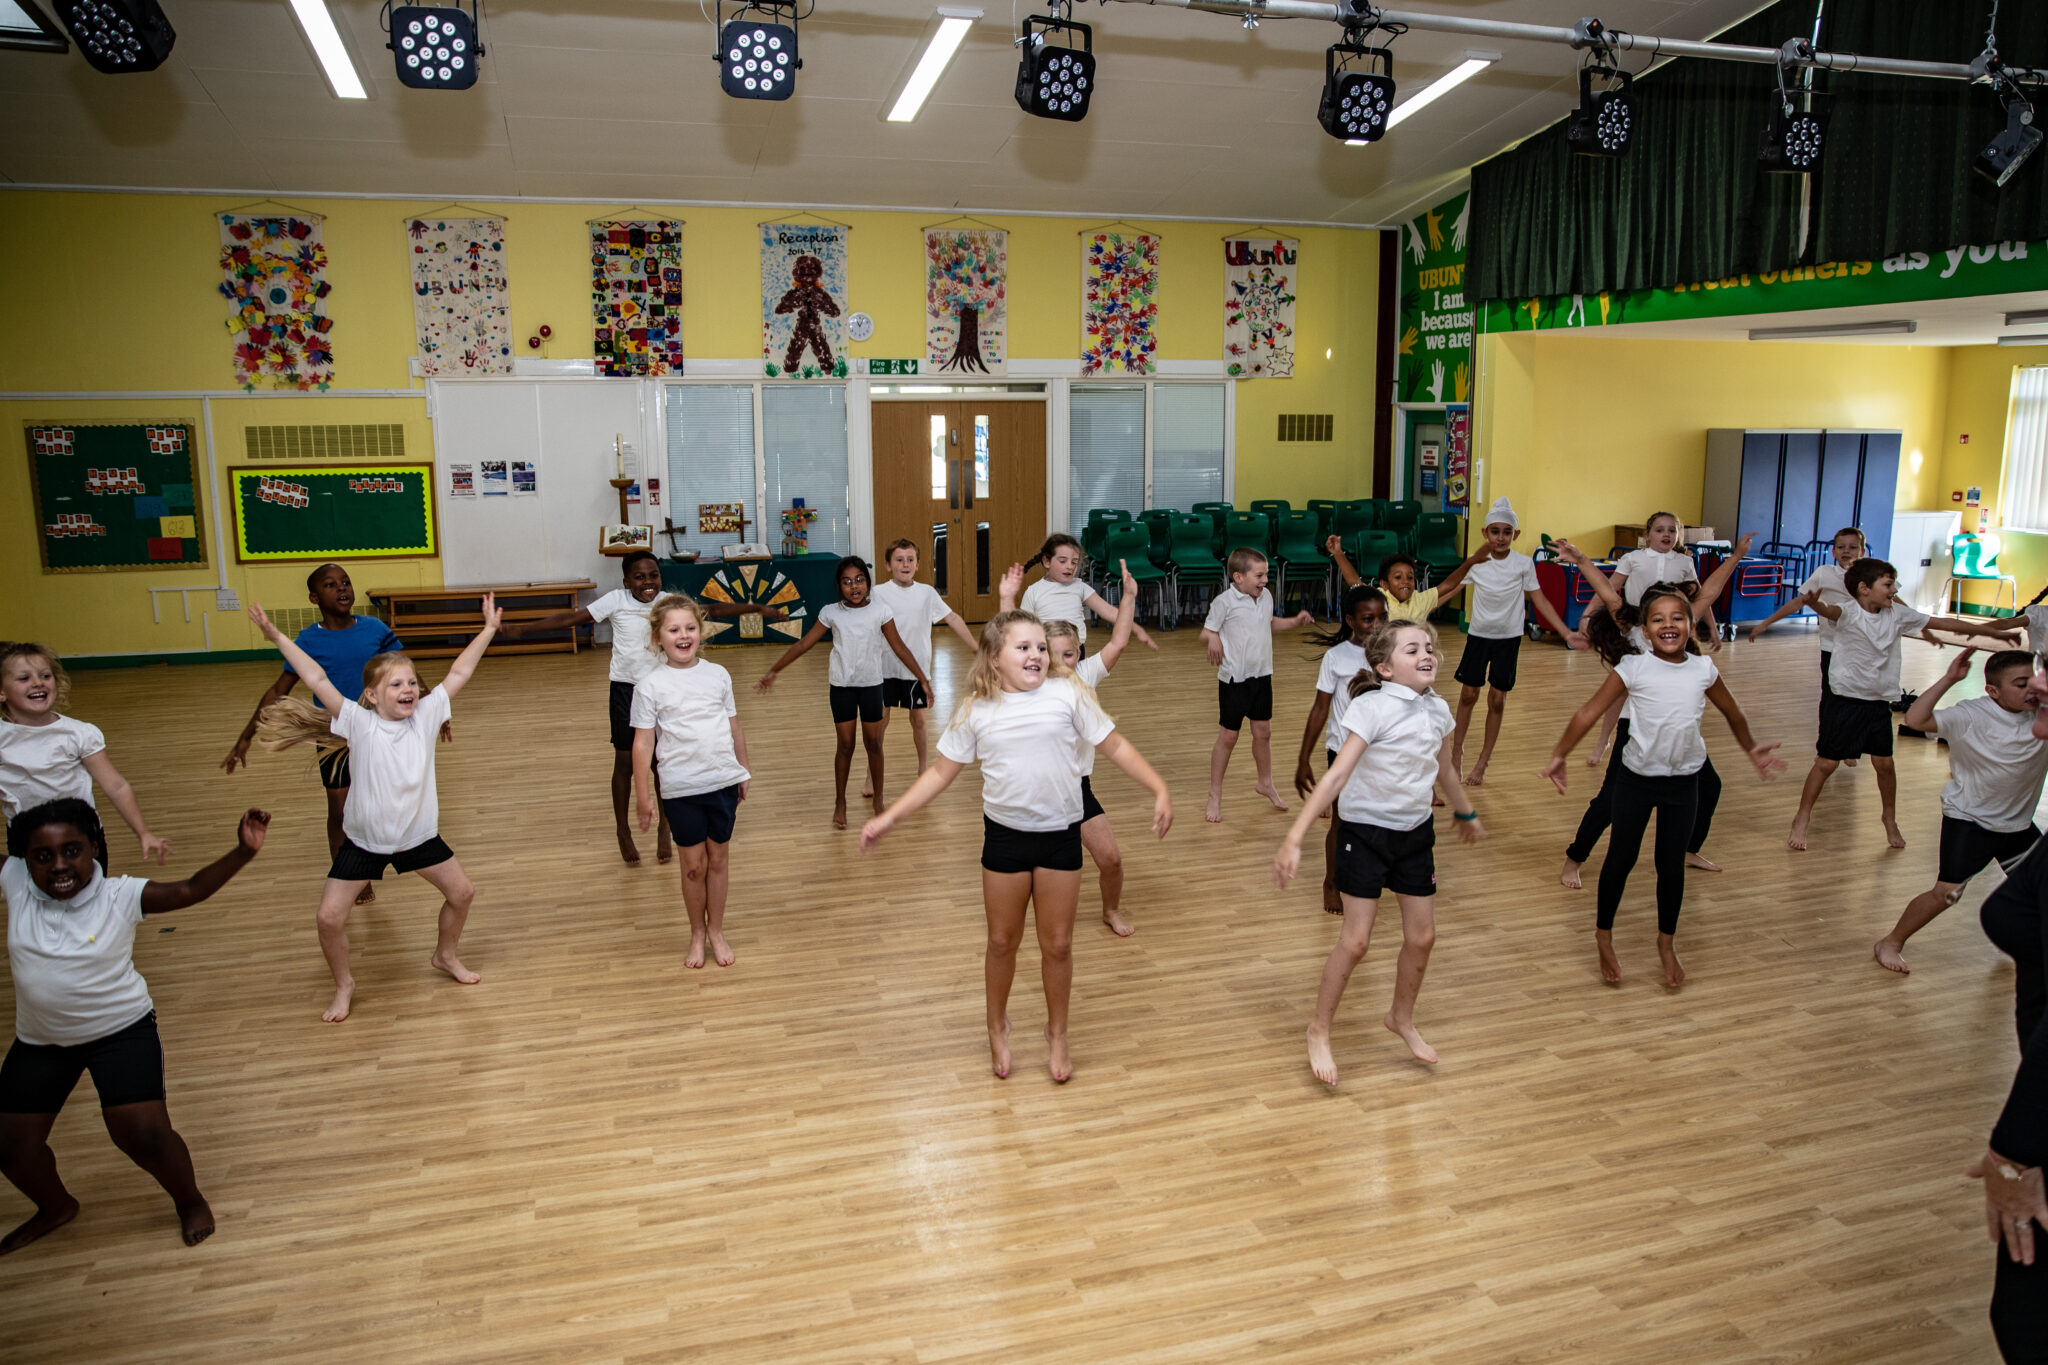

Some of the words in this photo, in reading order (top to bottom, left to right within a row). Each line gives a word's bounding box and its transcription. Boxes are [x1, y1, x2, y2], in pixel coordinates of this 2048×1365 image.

[778, 232, 838, 249] Reception
[1882, 251, 1930, 273] as
[1940, 240, 2028, 278] you
[415, 277, 507, 296] UBUNTU
[1434, 291, 1439, 310] I
[1442, 292, 1465, 310] am
[1425, 334, 1446, 350] we
[1448, 332, 1472, 348] are
[33, 428, 75, 441] HEAD
[146, 428, 186, 440] HEAD
[36, 443, 74, 455] GIRL
[151, 440, 183, 454] BOY
[88, 468, 138, 481] HOUSE
[86, 480, 146, 495] CAPTAINS
[260, 477, 308, 497] SCHOOL
[349, 478, 404, 493] PREFECTS
[256, 488, 310, 508] COUNCIL
[58, 514, 92, 525] VICE
[46, 524, 106, 537] CAPTAINS
